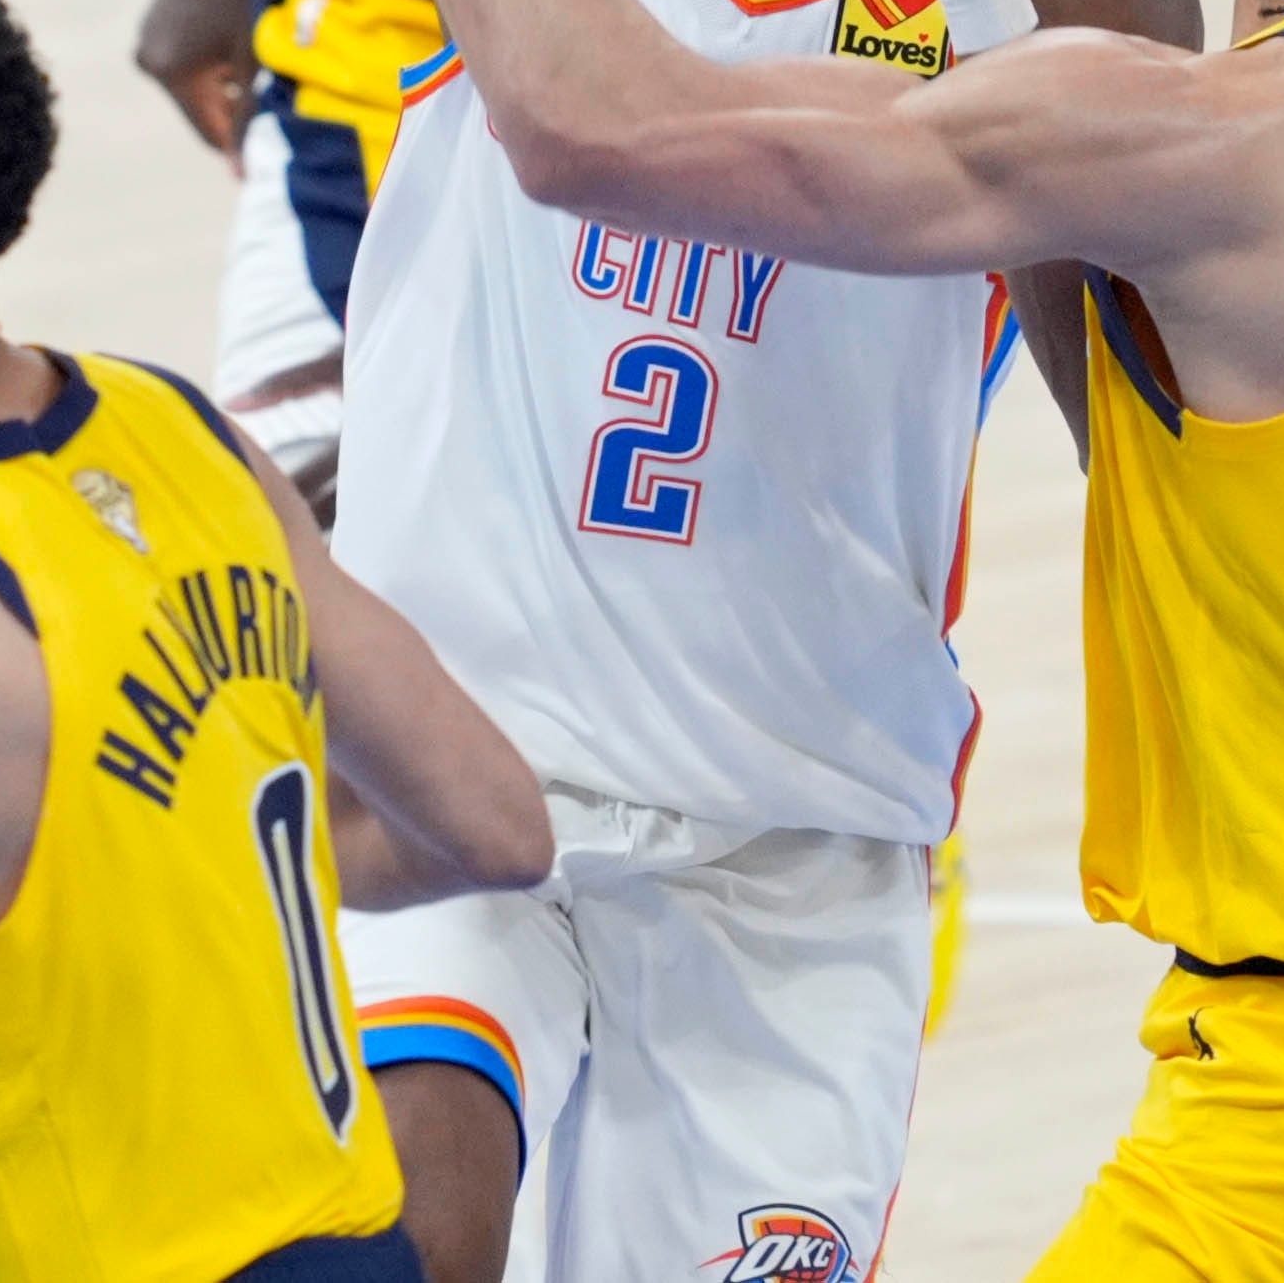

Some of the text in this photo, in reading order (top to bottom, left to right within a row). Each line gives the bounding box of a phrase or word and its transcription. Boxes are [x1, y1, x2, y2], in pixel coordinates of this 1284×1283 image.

[572, 217, 786, 344] CITY
[578, 334, 719, 546] 2
[252, 759, 360, 1148] 0
